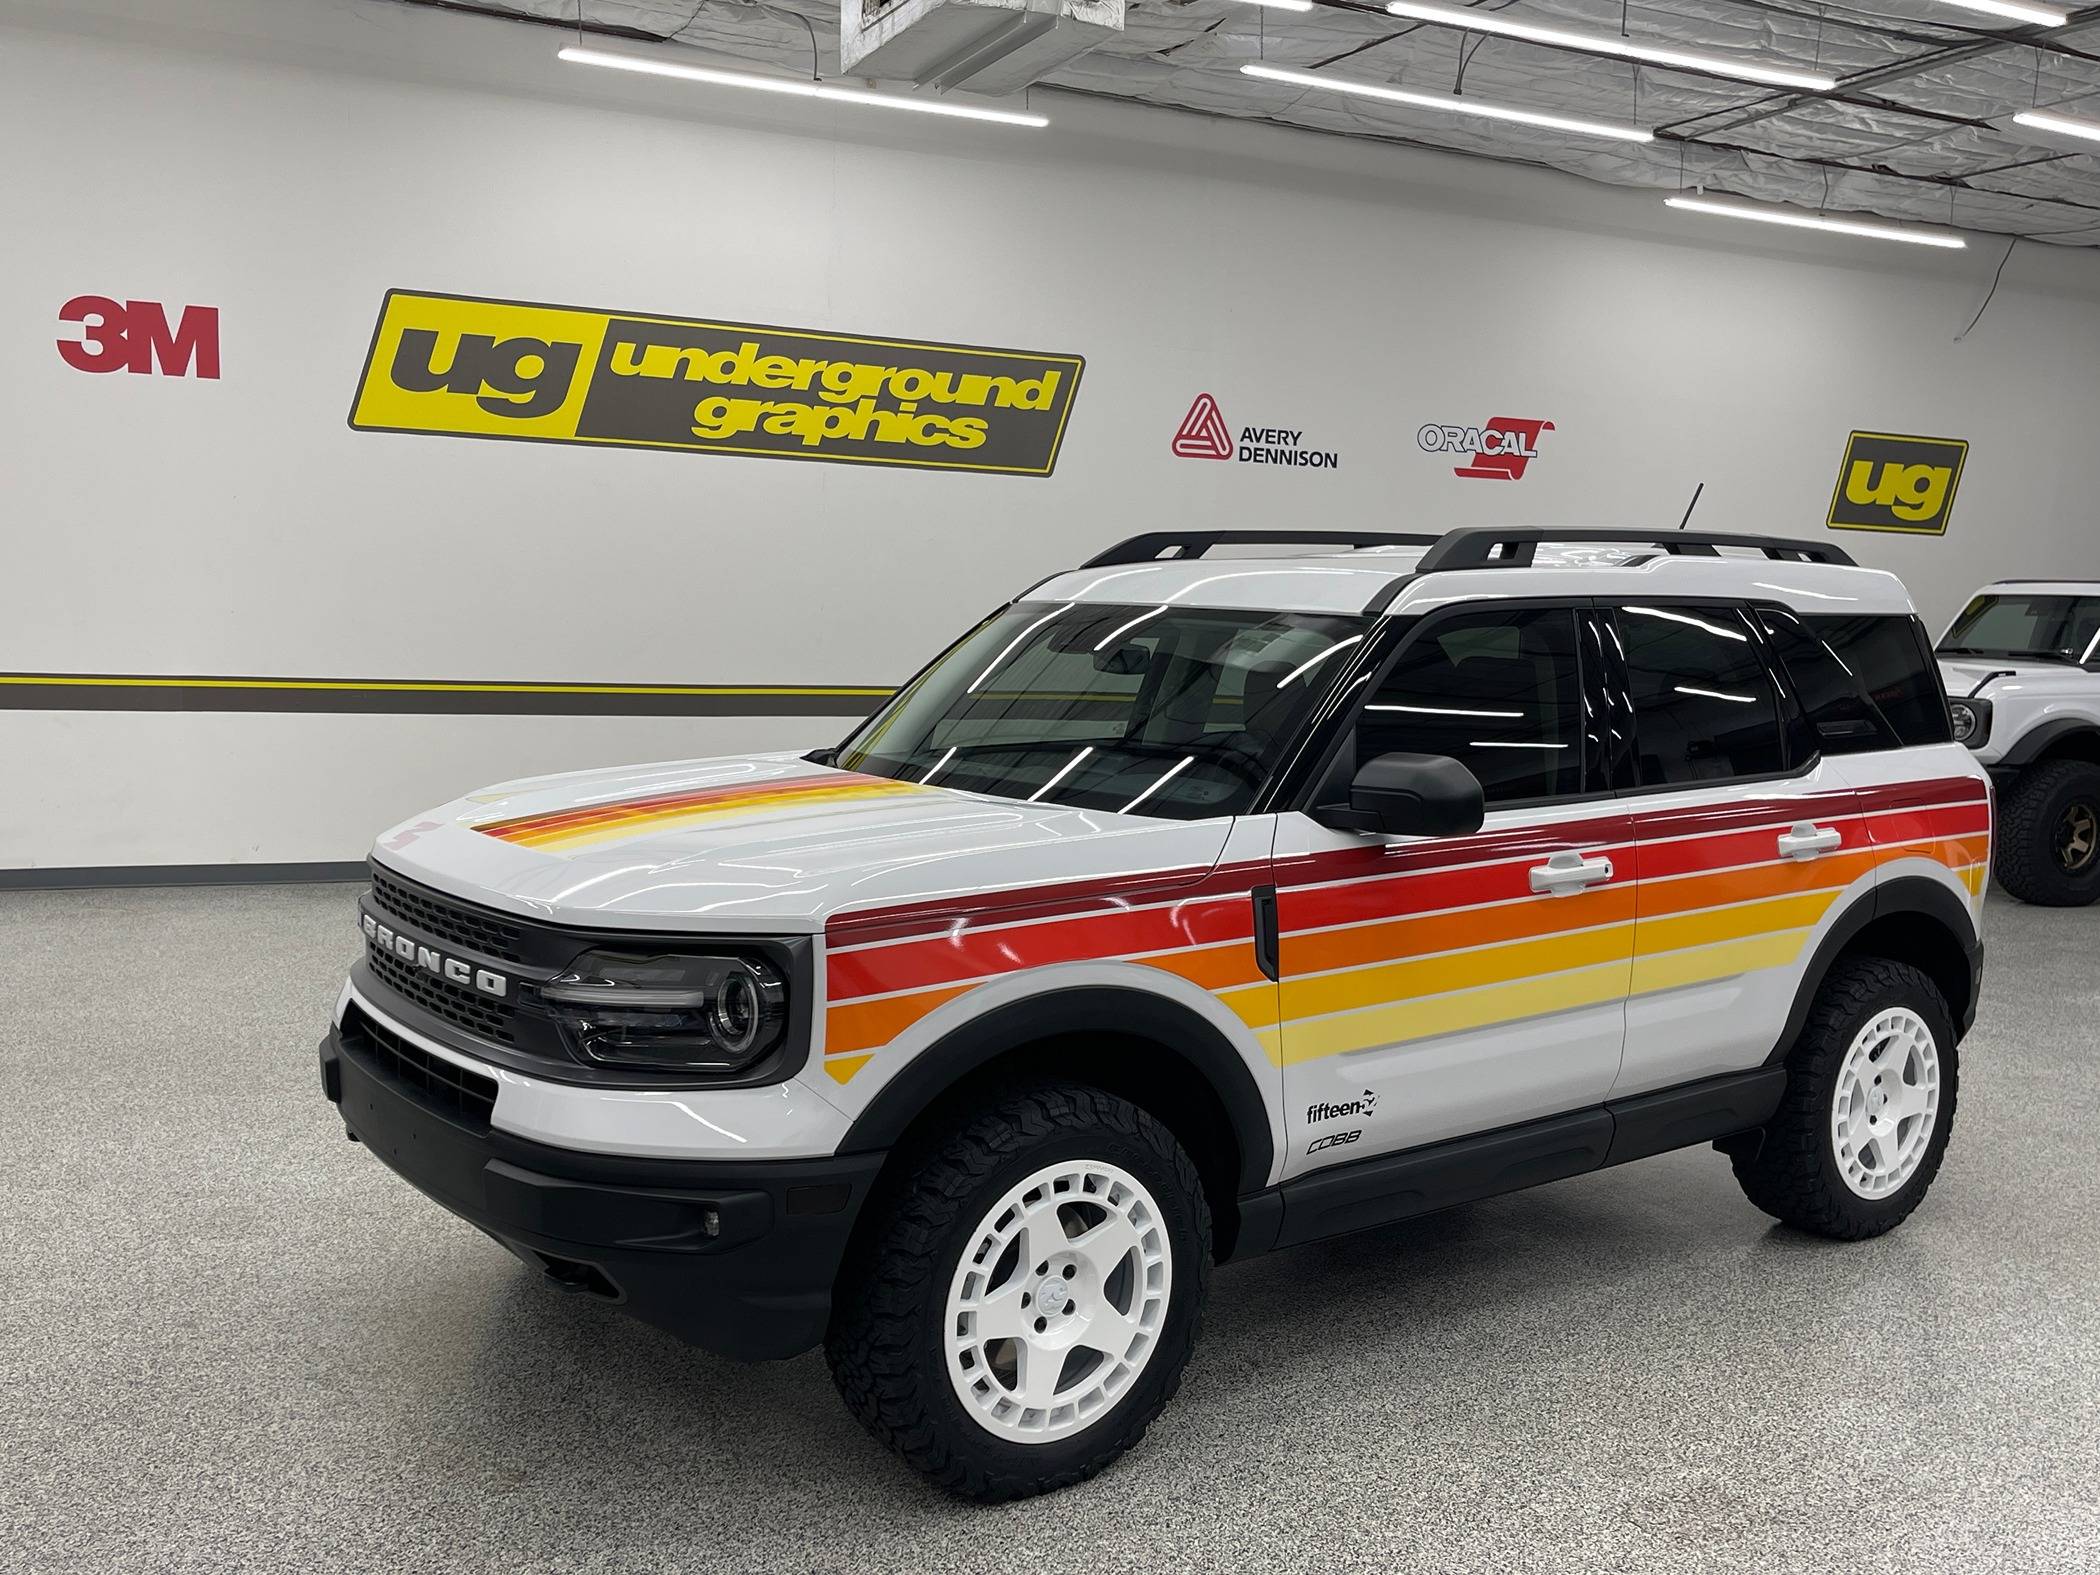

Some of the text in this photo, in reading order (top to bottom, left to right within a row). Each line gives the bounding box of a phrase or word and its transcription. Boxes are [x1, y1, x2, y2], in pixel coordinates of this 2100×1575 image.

[57, 295, 220, 380] 3M
[390, 328, 583, 418] ug
[609, 342, 1061, 411] underground
[691, 396, 989, 449] graphics
[1240, 427, 1302, 446] AVERY
[1417, 423, 1537, 458] ORACAL
[1239, 446, 1338, 468] DENNISON
[1846, 460, 1952, 521] ug
[363, 914, 507, 997] BRONCO
[1306, 1130, 1362, 1155] COBB
